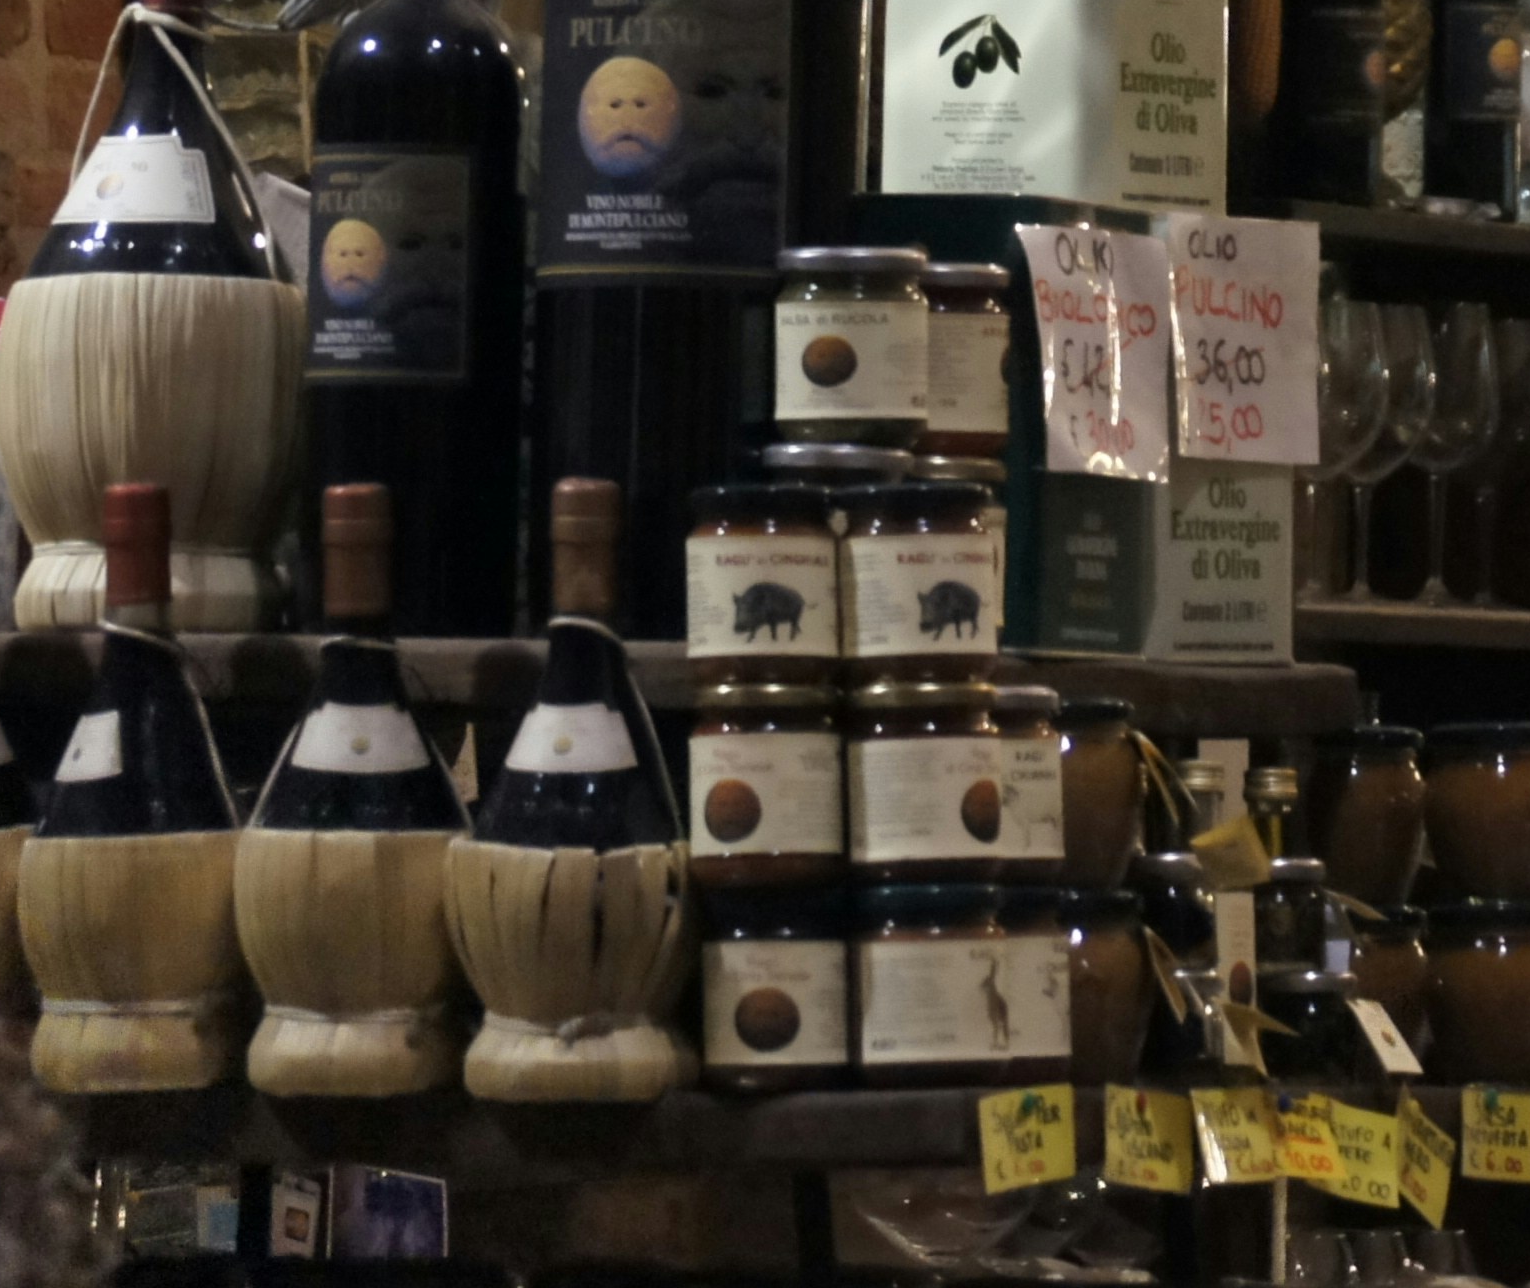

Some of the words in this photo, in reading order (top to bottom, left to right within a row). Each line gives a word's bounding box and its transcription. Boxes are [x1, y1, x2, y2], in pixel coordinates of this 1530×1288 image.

[1150, 32, 1187, 64] Olio
[1120, 62, 1217, 104] Extravergine
[1136, 101, 1151, 132] di
[1155, 103, 1198, 135] Oliva
[1187, 229, 1238, 261] OLIO
[1034, 278, 1158, 337] BIOLOICO
[1173, 264, 1284, 329] PULCINO
[1197, 337, 1266, 396] 36,00
[1208, 477, 1247, 509] Olio
[1170, 511, 1281, 547] Extravergine
[1191, 549, 1209, 580] di
[1214, 549, 1261, 580] Oliva
